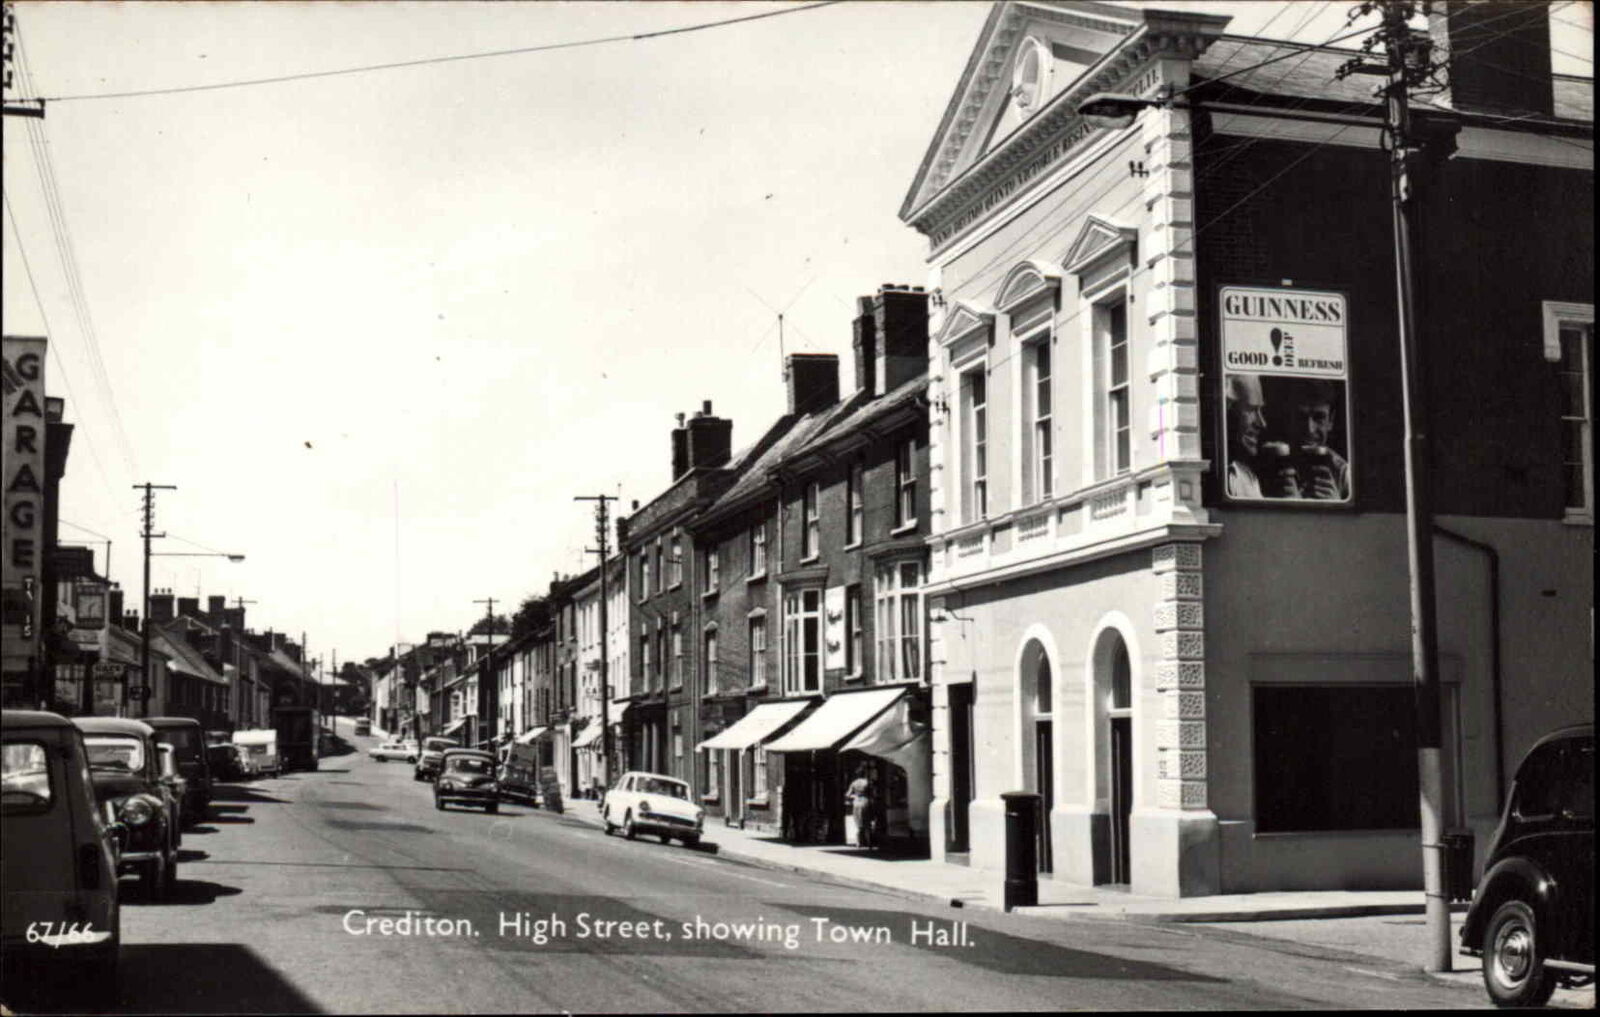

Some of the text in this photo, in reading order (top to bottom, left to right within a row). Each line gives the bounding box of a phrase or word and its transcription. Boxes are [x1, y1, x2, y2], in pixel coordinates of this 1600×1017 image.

[1225, 295, 1341, 321] GUINNESS
[1228, 351, 1268, 366] GOOD
[1284, 331, 1295, 367] DEEP
[10, 353, 41, 568] GARAGE
